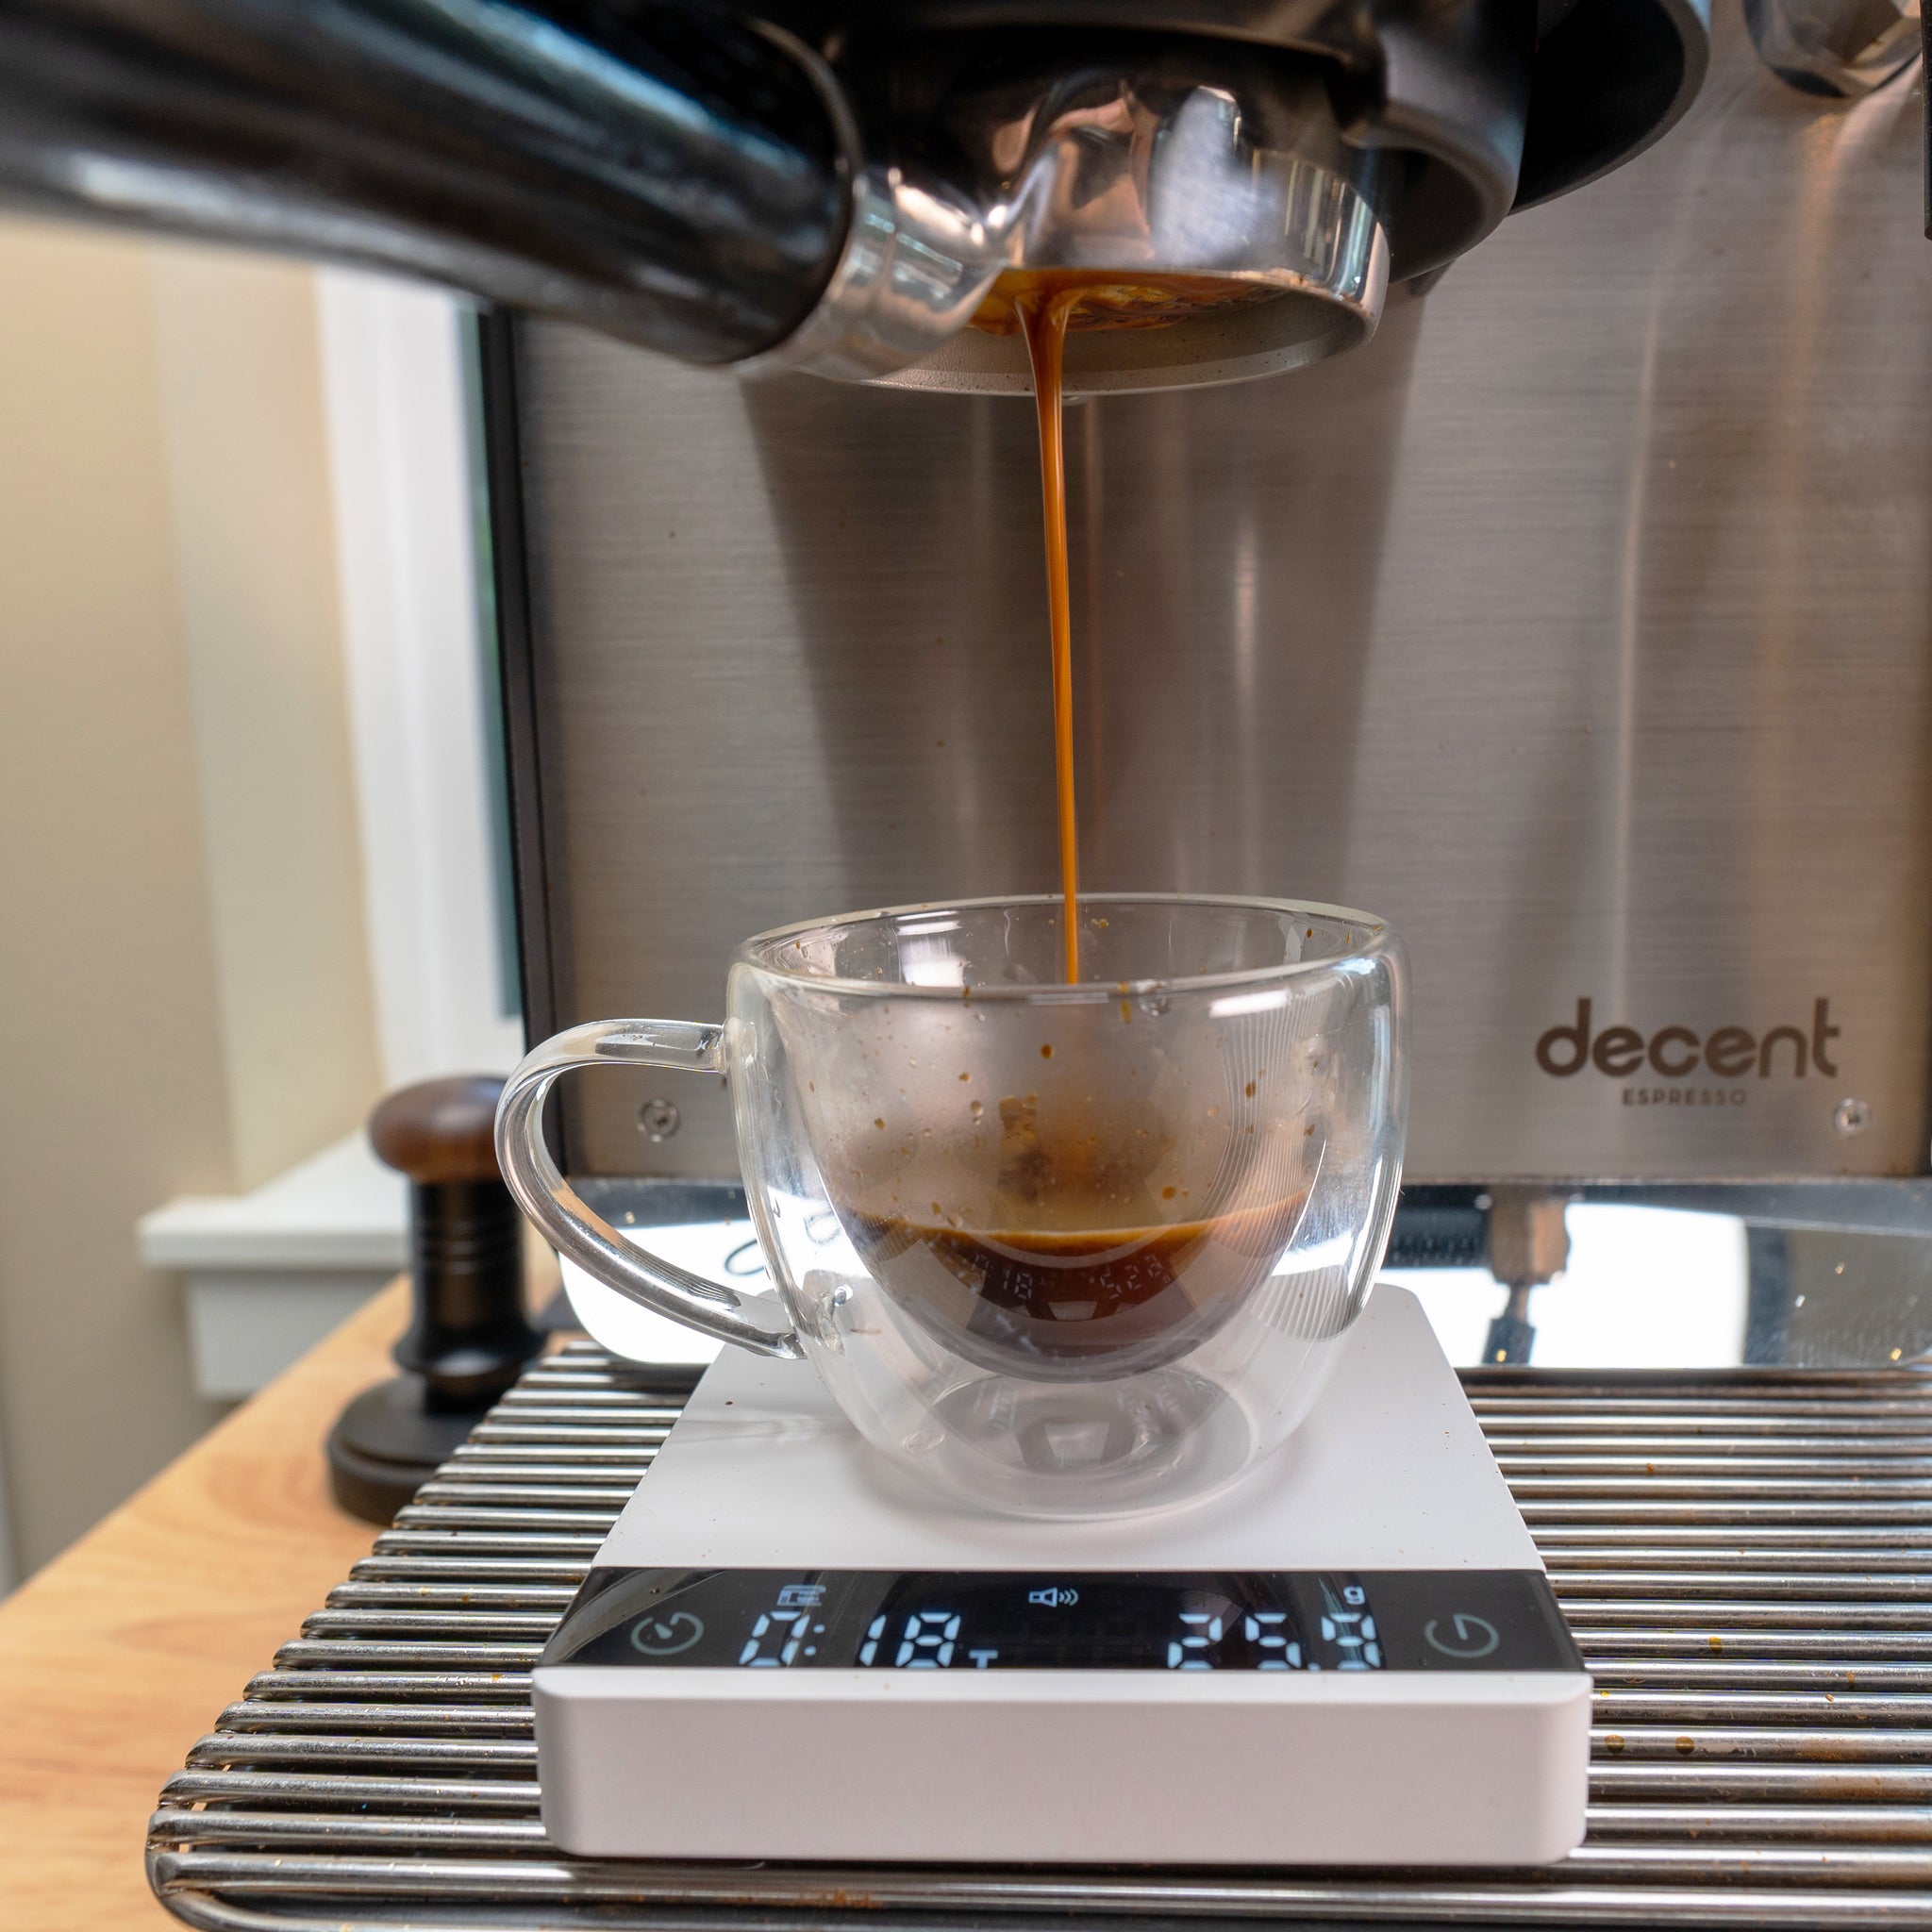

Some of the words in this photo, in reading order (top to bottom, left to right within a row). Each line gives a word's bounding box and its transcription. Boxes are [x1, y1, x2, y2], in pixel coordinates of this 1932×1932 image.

[1536, 997, 1839, 1077] decent
[1623, 1089, 1747, 1106] ESPRESSO
[1167, 1612, 1381, 1670] 25.9
